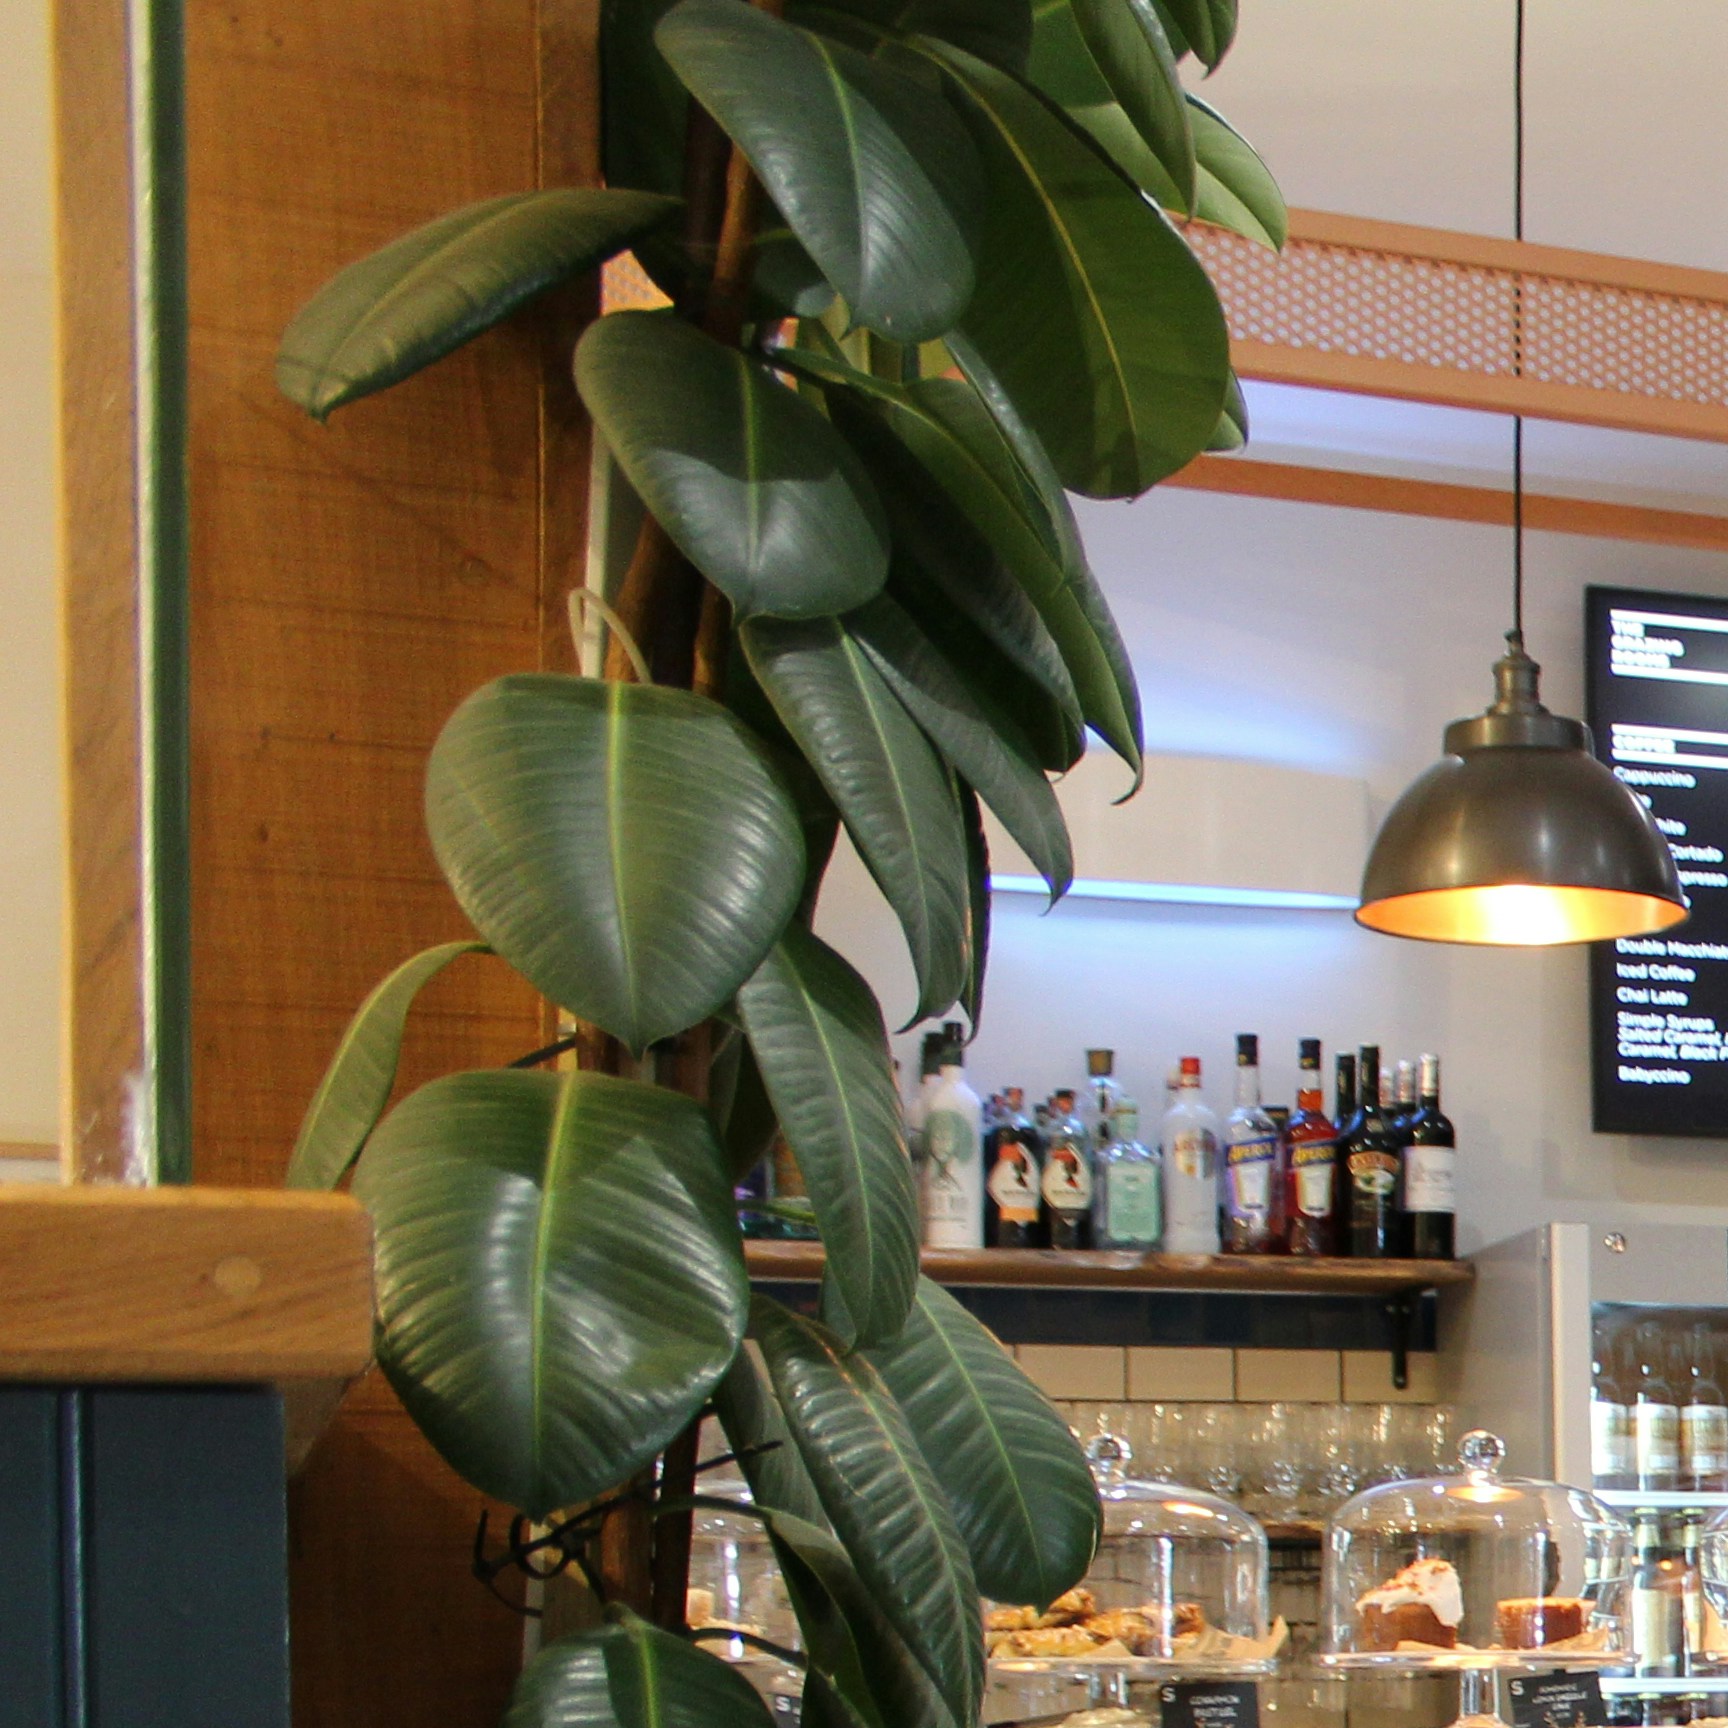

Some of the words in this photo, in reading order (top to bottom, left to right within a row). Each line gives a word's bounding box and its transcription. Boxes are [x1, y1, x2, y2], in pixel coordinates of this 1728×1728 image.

[1612, 733, 1676, 754] COFFEE
[1614, 765, 1696, 788] Cappuccino
[1655, 817, 1687, 836] hite
[1677, 870, 1728, 887] spresso
[1615, 937, 1667, 956] Double
[1616, 962, 1648, 979] Iced
[1649, 963, 1696, 983] Coffee
[1616, 986, 1649, 1004] Chai
[1650, 988, 1688, 1006] Latte
[1617, 1011, 1666, 1030] Simple
[1666, 1013, 1715, 1032] Syrups
[1617, 1027, 1663, 1044] Salted
[1679, 1044, 1719, 1061] Black
[1618, 1065, 1691, 1085] Babyccino
